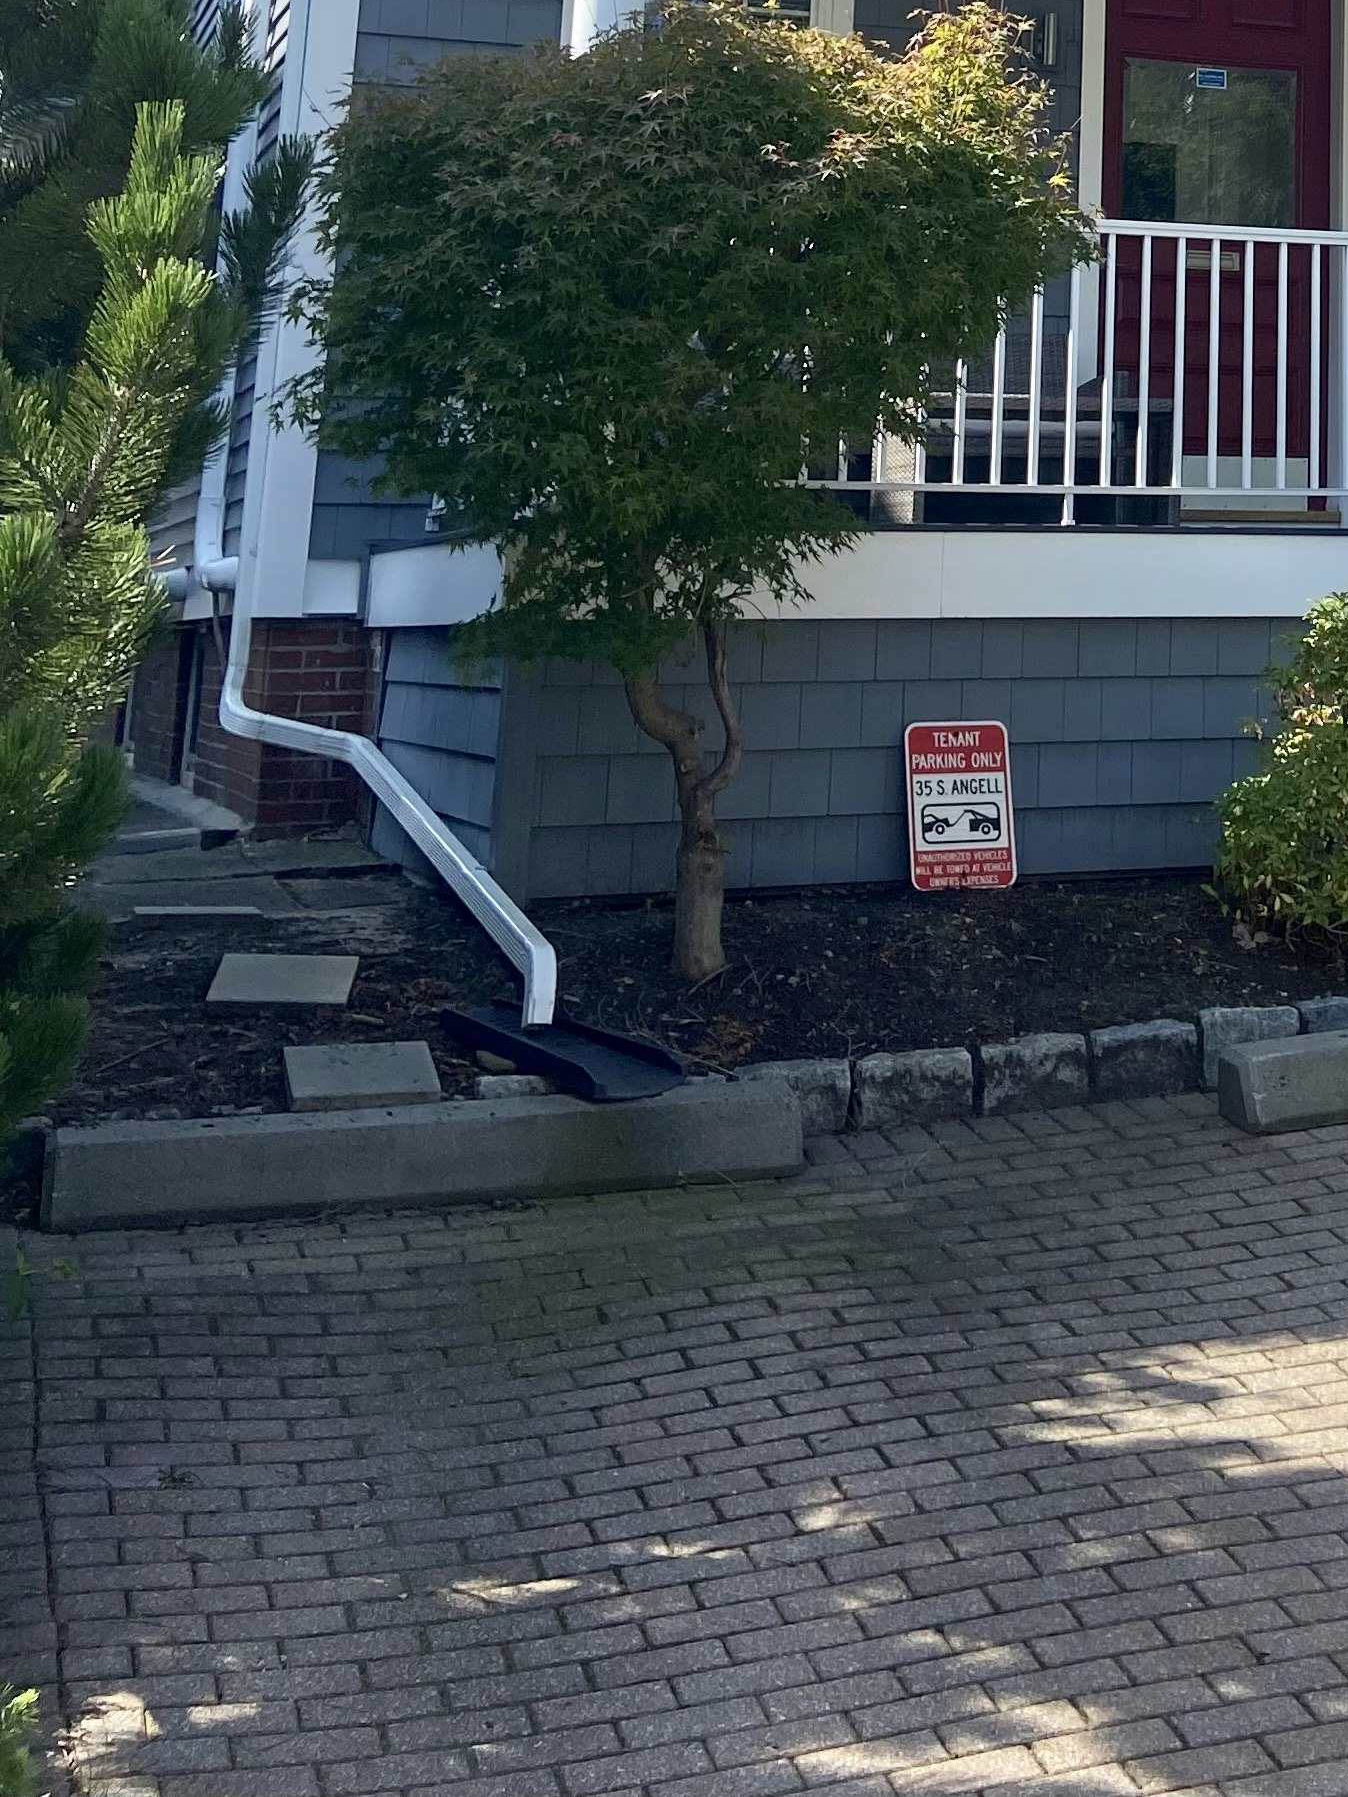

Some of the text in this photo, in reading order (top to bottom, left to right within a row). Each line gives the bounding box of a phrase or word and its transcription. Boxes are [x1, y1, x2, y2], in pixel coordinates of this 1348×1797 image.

[932, 731, 981, 748] TENANT
[911, 751, 1003, 770] PARKING ONLY
[915, 780, 933, 797] 35
[951, 778, 1003, 795] ANGELL
[973, 850, 1008, 860] VEHICLES
